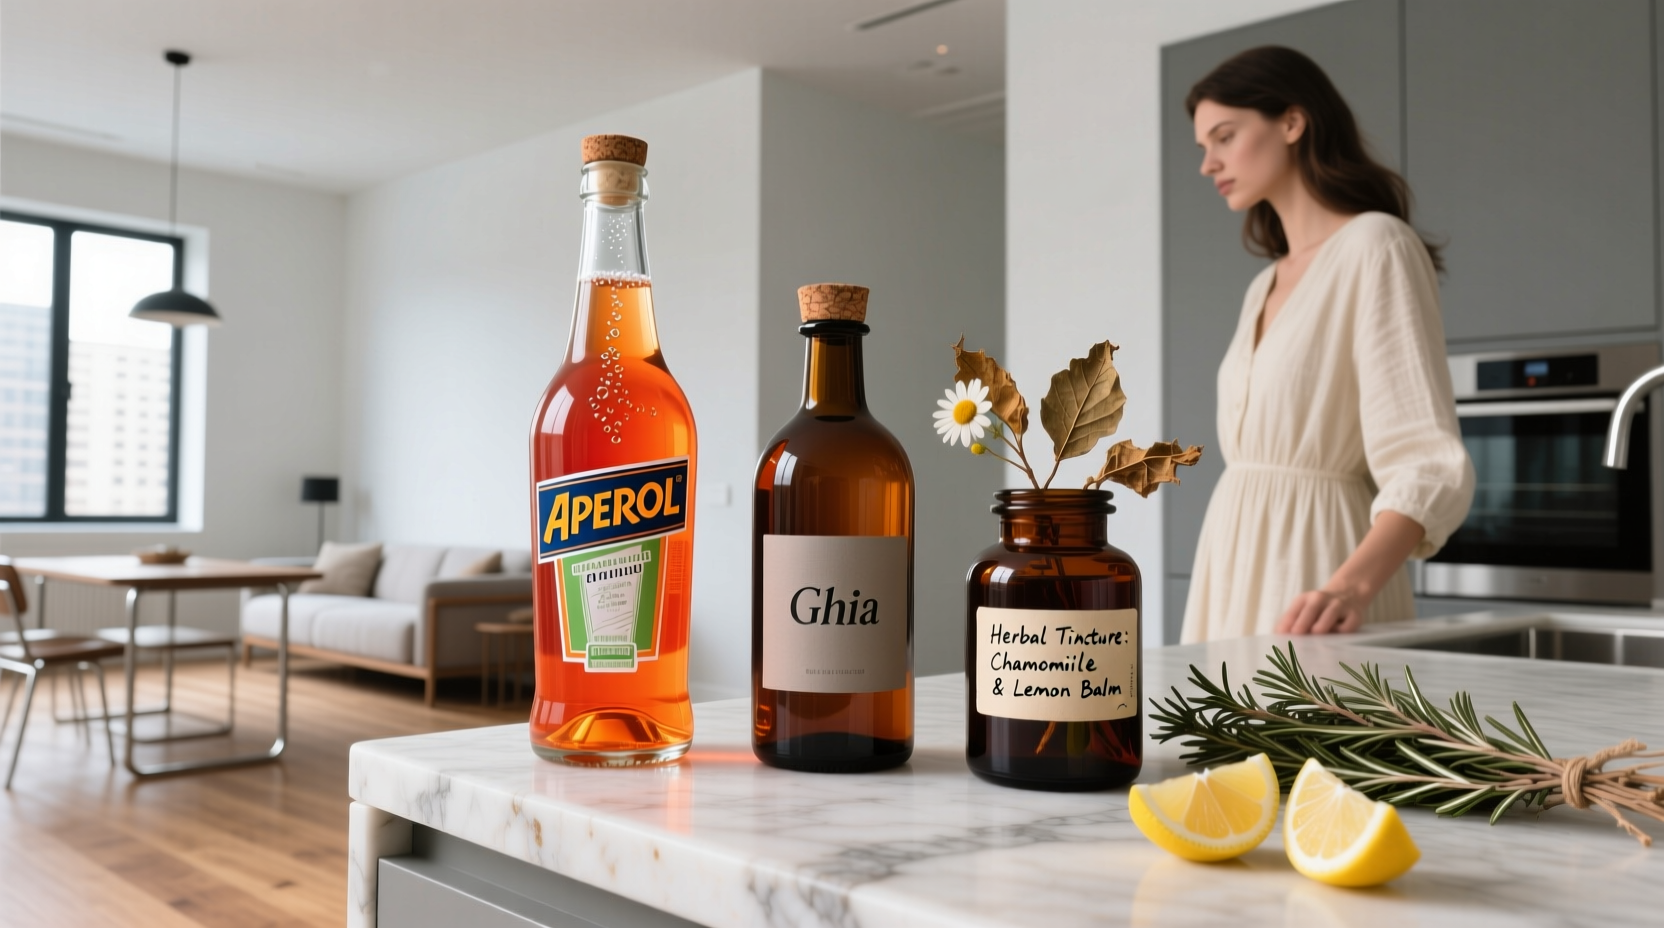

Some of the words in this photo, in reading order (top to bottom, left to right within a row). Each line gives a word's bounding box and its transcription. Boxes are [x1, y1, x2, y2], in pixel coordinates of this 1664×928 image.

[543, 477, 680, 544] APEROL
[790, 586, 879, 626] Ghia
[990, 623, 1047, 645] Herbal
[1055, 626, 1129, 645] Tincture:
[992, 677, 1004, 696] &
[1013, 679, 1071, 697] Lemon
[1081, 677, 1122, 699] Balm
